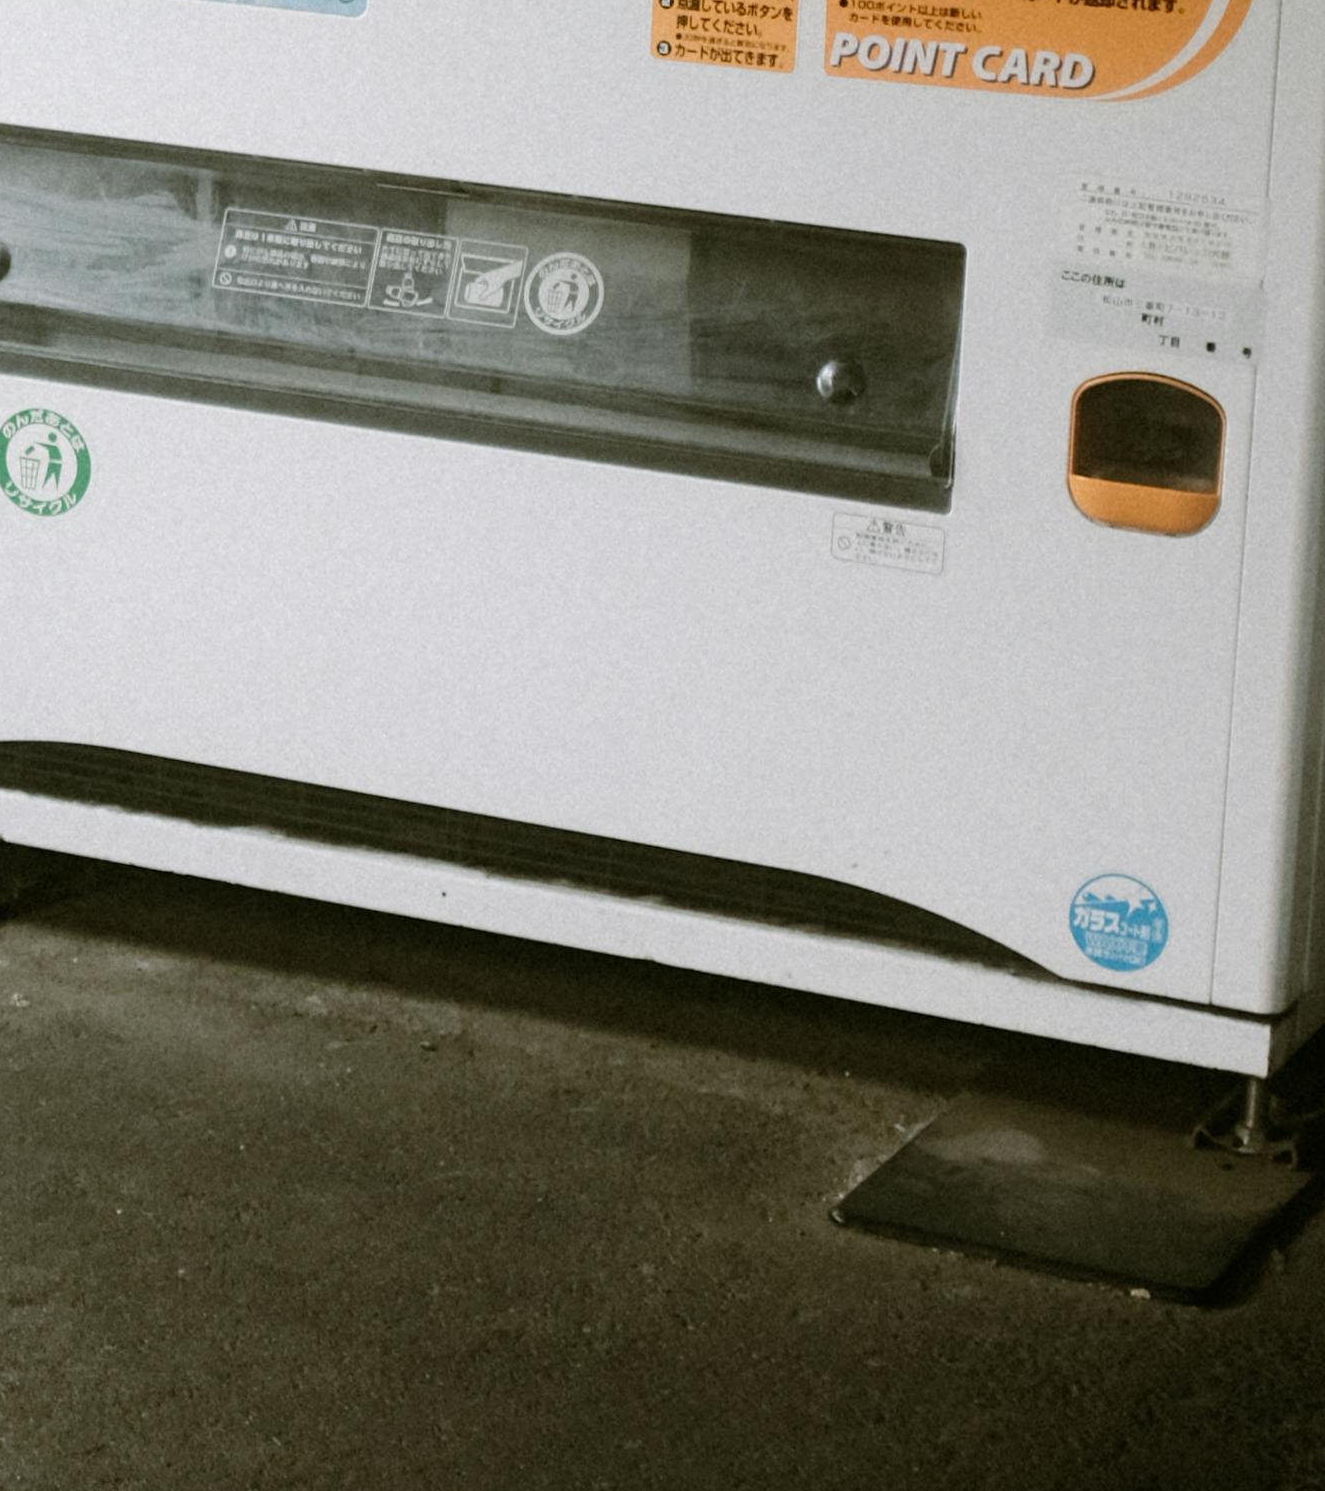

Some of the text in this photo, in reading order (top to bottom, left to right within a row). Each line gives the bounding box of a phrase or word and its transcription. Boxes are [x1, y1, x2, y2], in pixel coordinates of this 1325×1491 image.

[676, 14, 763, 38] 押してください。
[675, 44, 784, 69] カードが出てきます。
[829, 31, 1096, 90] POINT CARD
[1061, 269, 1126, 289] ここの住所は
[1158, 333, 1182, 349] 丁目
[2, 408, 86, 454] のんだあとは
[4, 480, 78, 517] リサイクル
